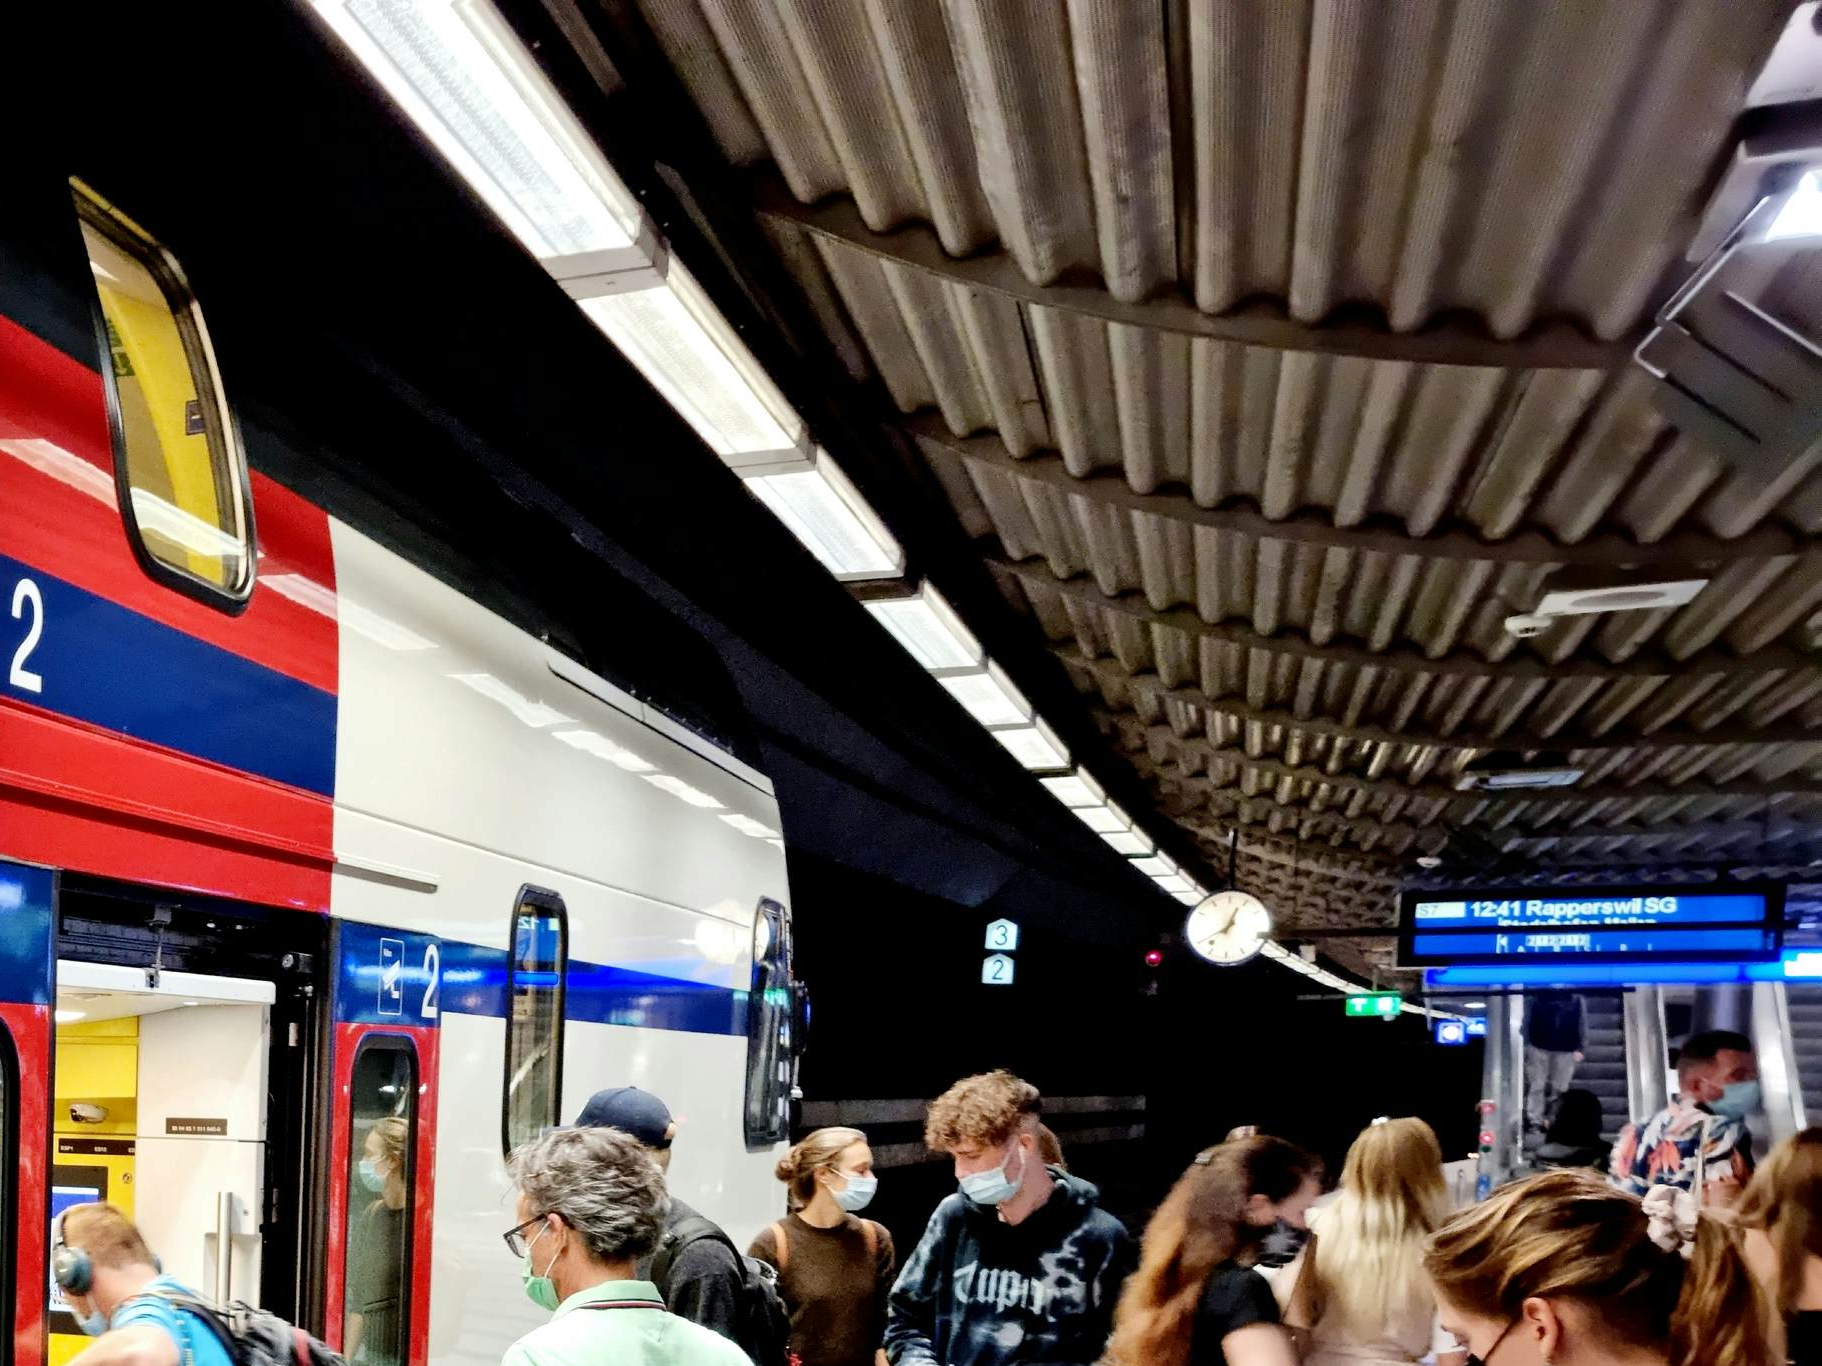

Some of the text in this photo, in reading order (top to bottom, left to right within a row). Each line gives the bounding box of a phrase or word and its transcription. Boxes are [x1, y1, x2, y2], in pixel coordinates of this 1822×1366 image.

[9, 578, 44, 693] 2
[1470, 901, 1522, 918] 12:41
[1525, 898, 1643, 918] Rapperswil
[1643, 896, 1678, 915] SG
[994, 925, 1008, 946] 3
[420, 943, 440, 1019] 2
[992, 960, 1004, 981] 2
